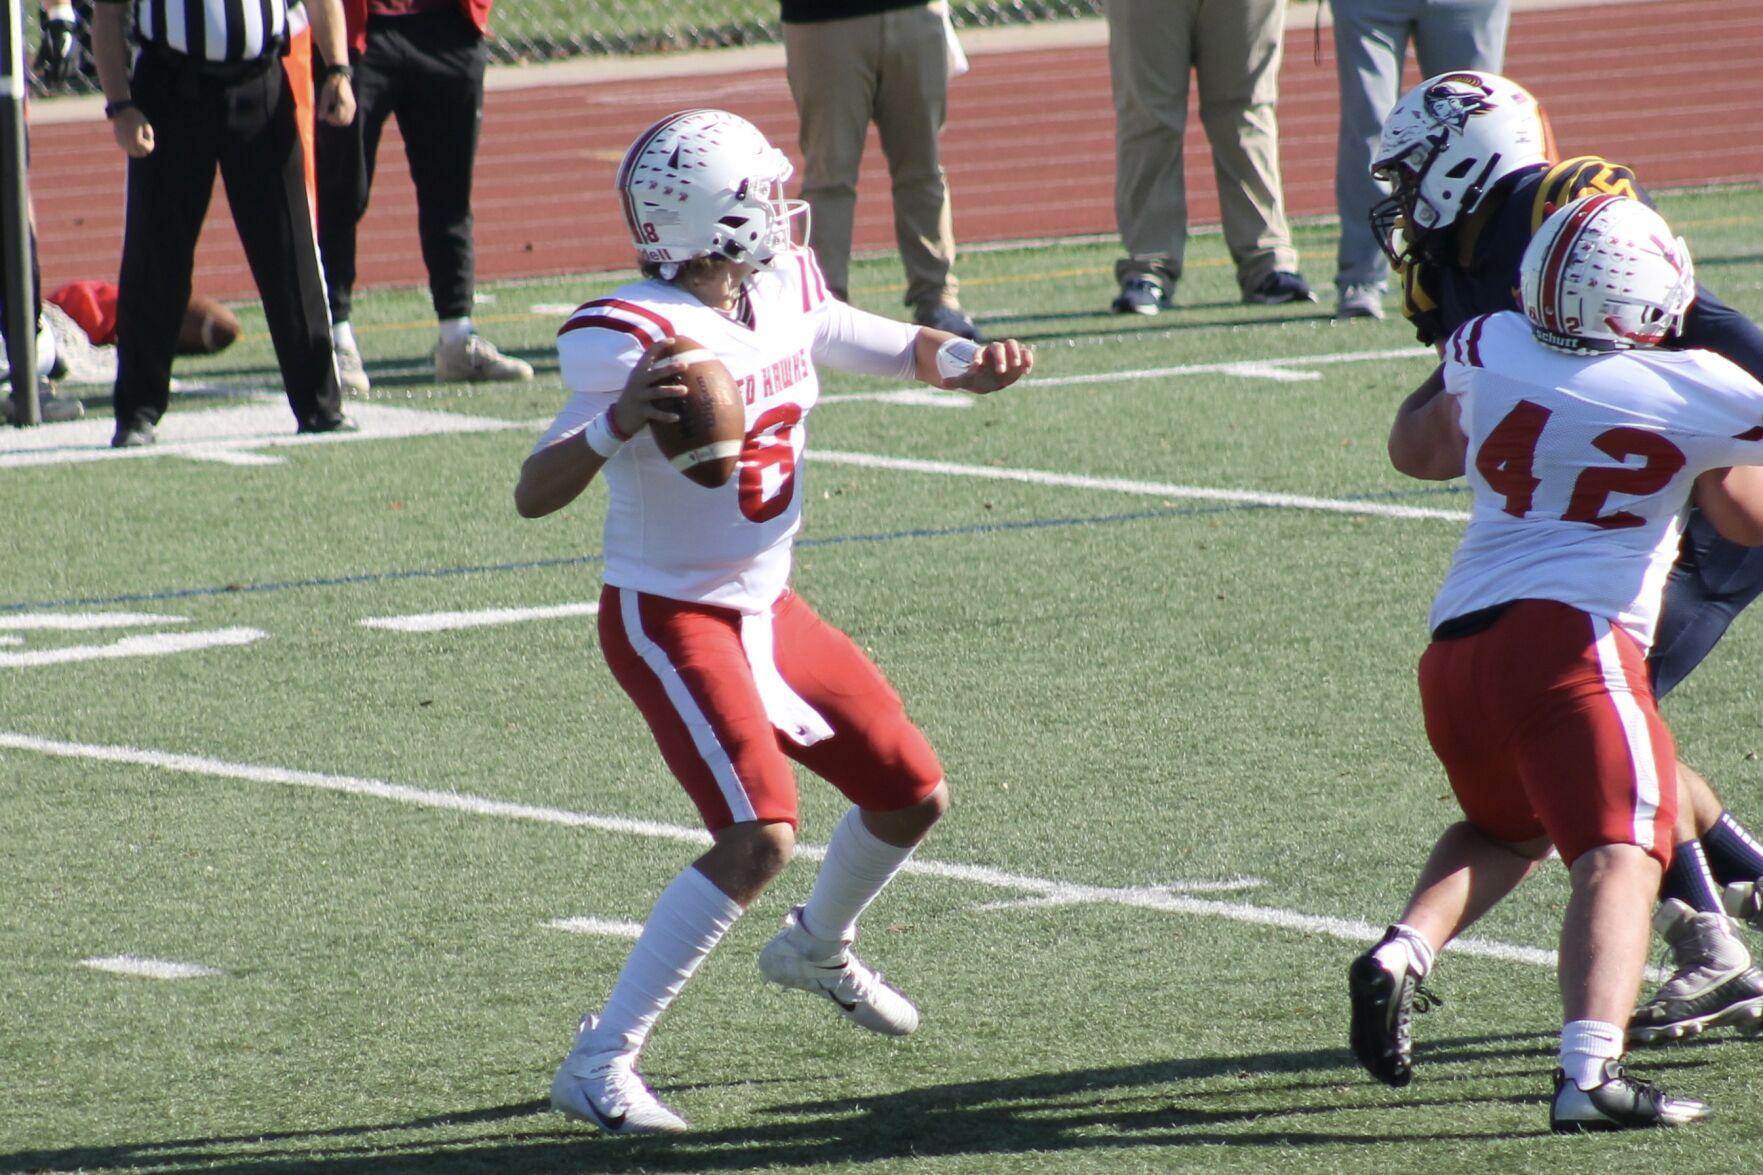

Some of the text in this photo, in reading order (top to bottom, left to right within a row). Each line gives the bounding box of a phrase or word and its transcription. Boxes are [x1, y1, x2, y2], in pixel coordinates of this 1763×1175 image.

[643, 222, 659, 243] 8
[1565, 317, 1583, 334] 2
[761, 348, 808, 398] HAWKS
[1475, 399, 1687, 530] 42
